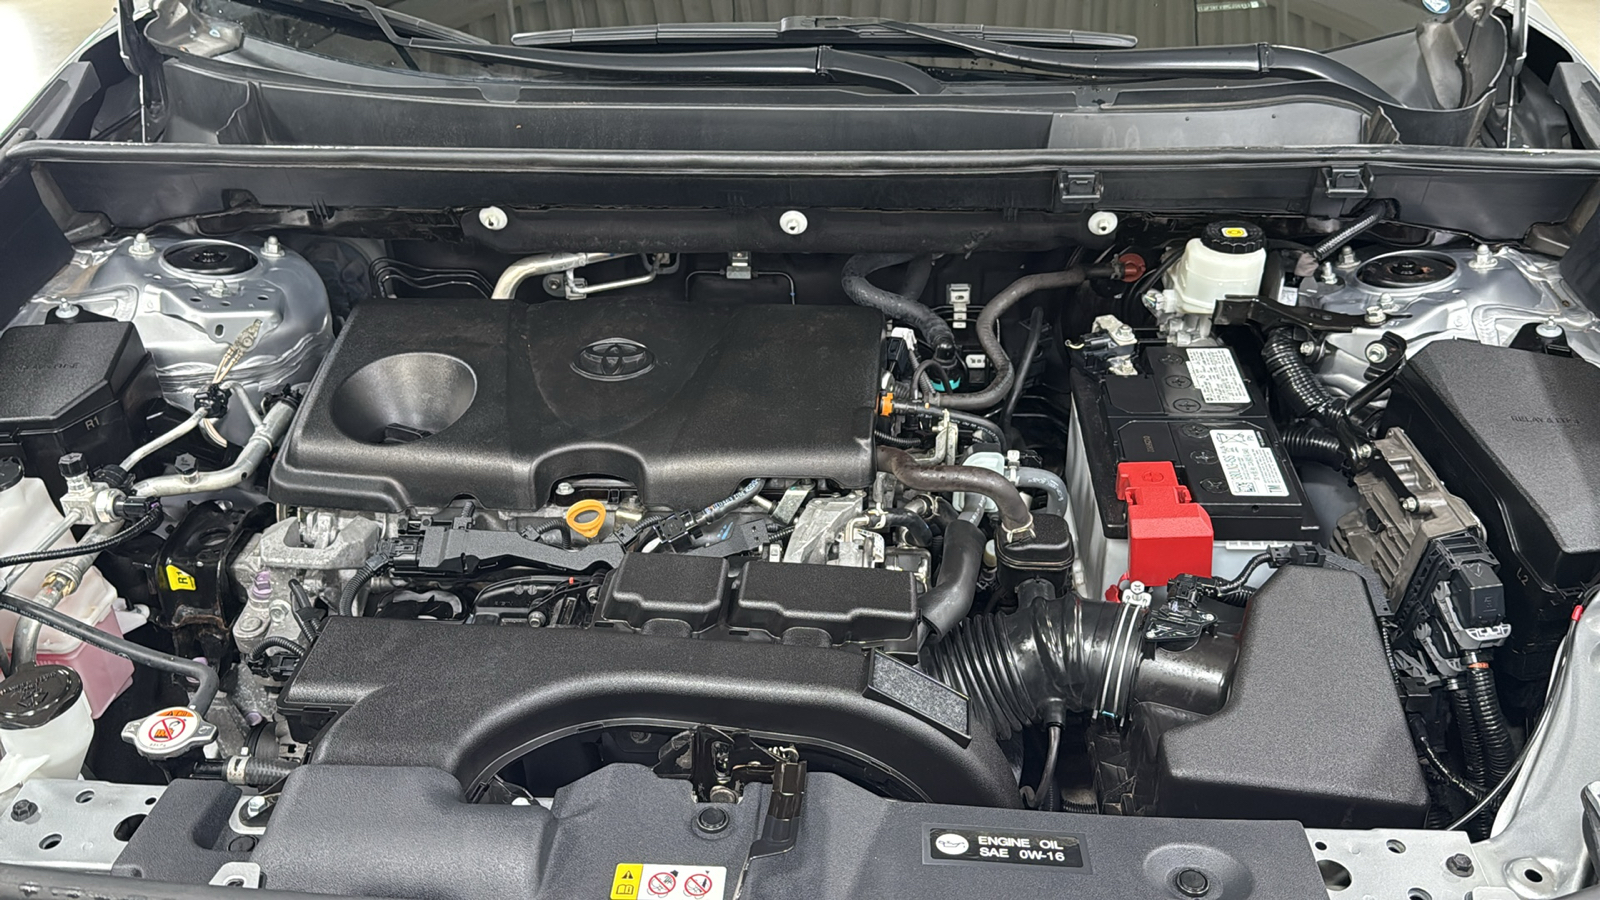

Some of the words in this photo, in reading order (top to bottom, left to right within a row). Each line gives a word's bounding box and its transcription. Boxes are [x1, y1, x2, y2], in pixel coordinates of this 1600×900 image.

[84, 416, 100, 430] R1
[1516, 567, 1528, 586] L2
[978, 836, 1030, 848] ENGINE
[1039, 839, 1064, 850] OIL
[979, 848, 1010, 858] SAE
[1019, 850, 1065, 862] 0W-16
